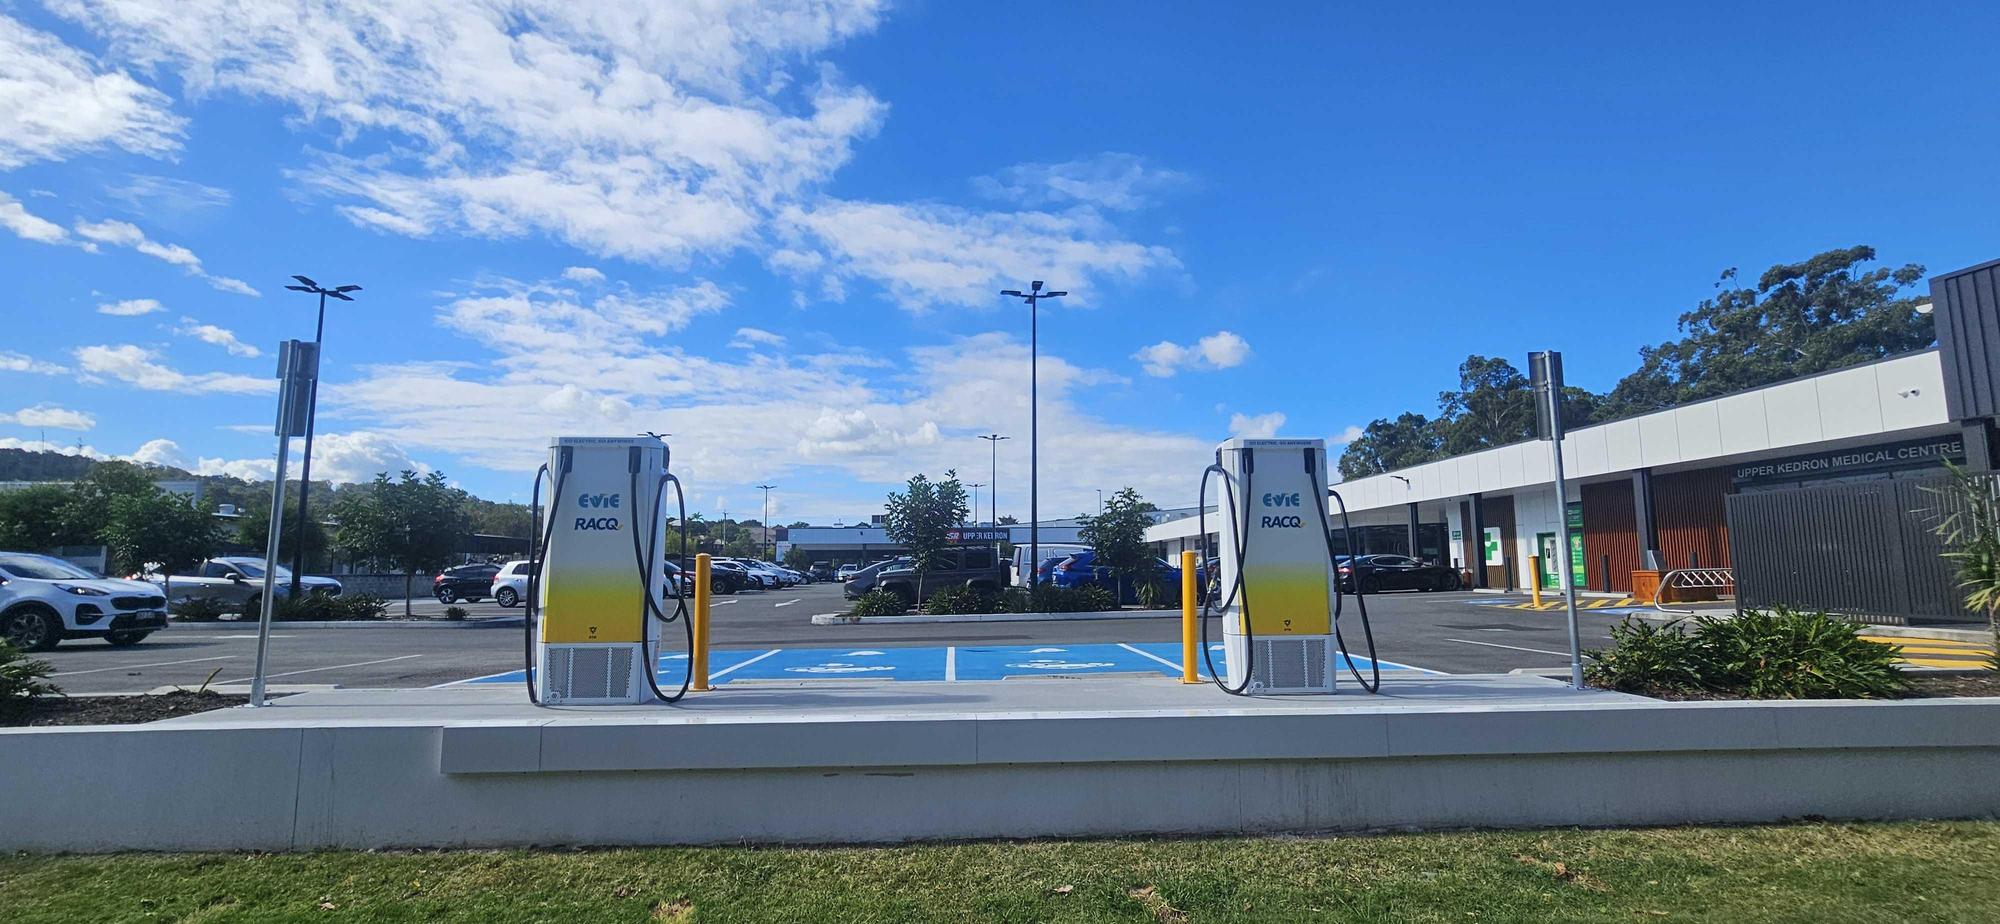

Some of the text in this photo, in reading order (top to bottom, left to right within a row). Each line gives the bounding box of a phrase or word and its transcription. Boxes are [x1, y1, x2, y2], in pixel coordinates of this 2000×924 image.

[1737, 441, 1962, 479] UPPER KEDRON MEDICAL CENTRE
[574, 517, 620, 531] RACQ
[1261, 516, 1302, 528] RACQ
